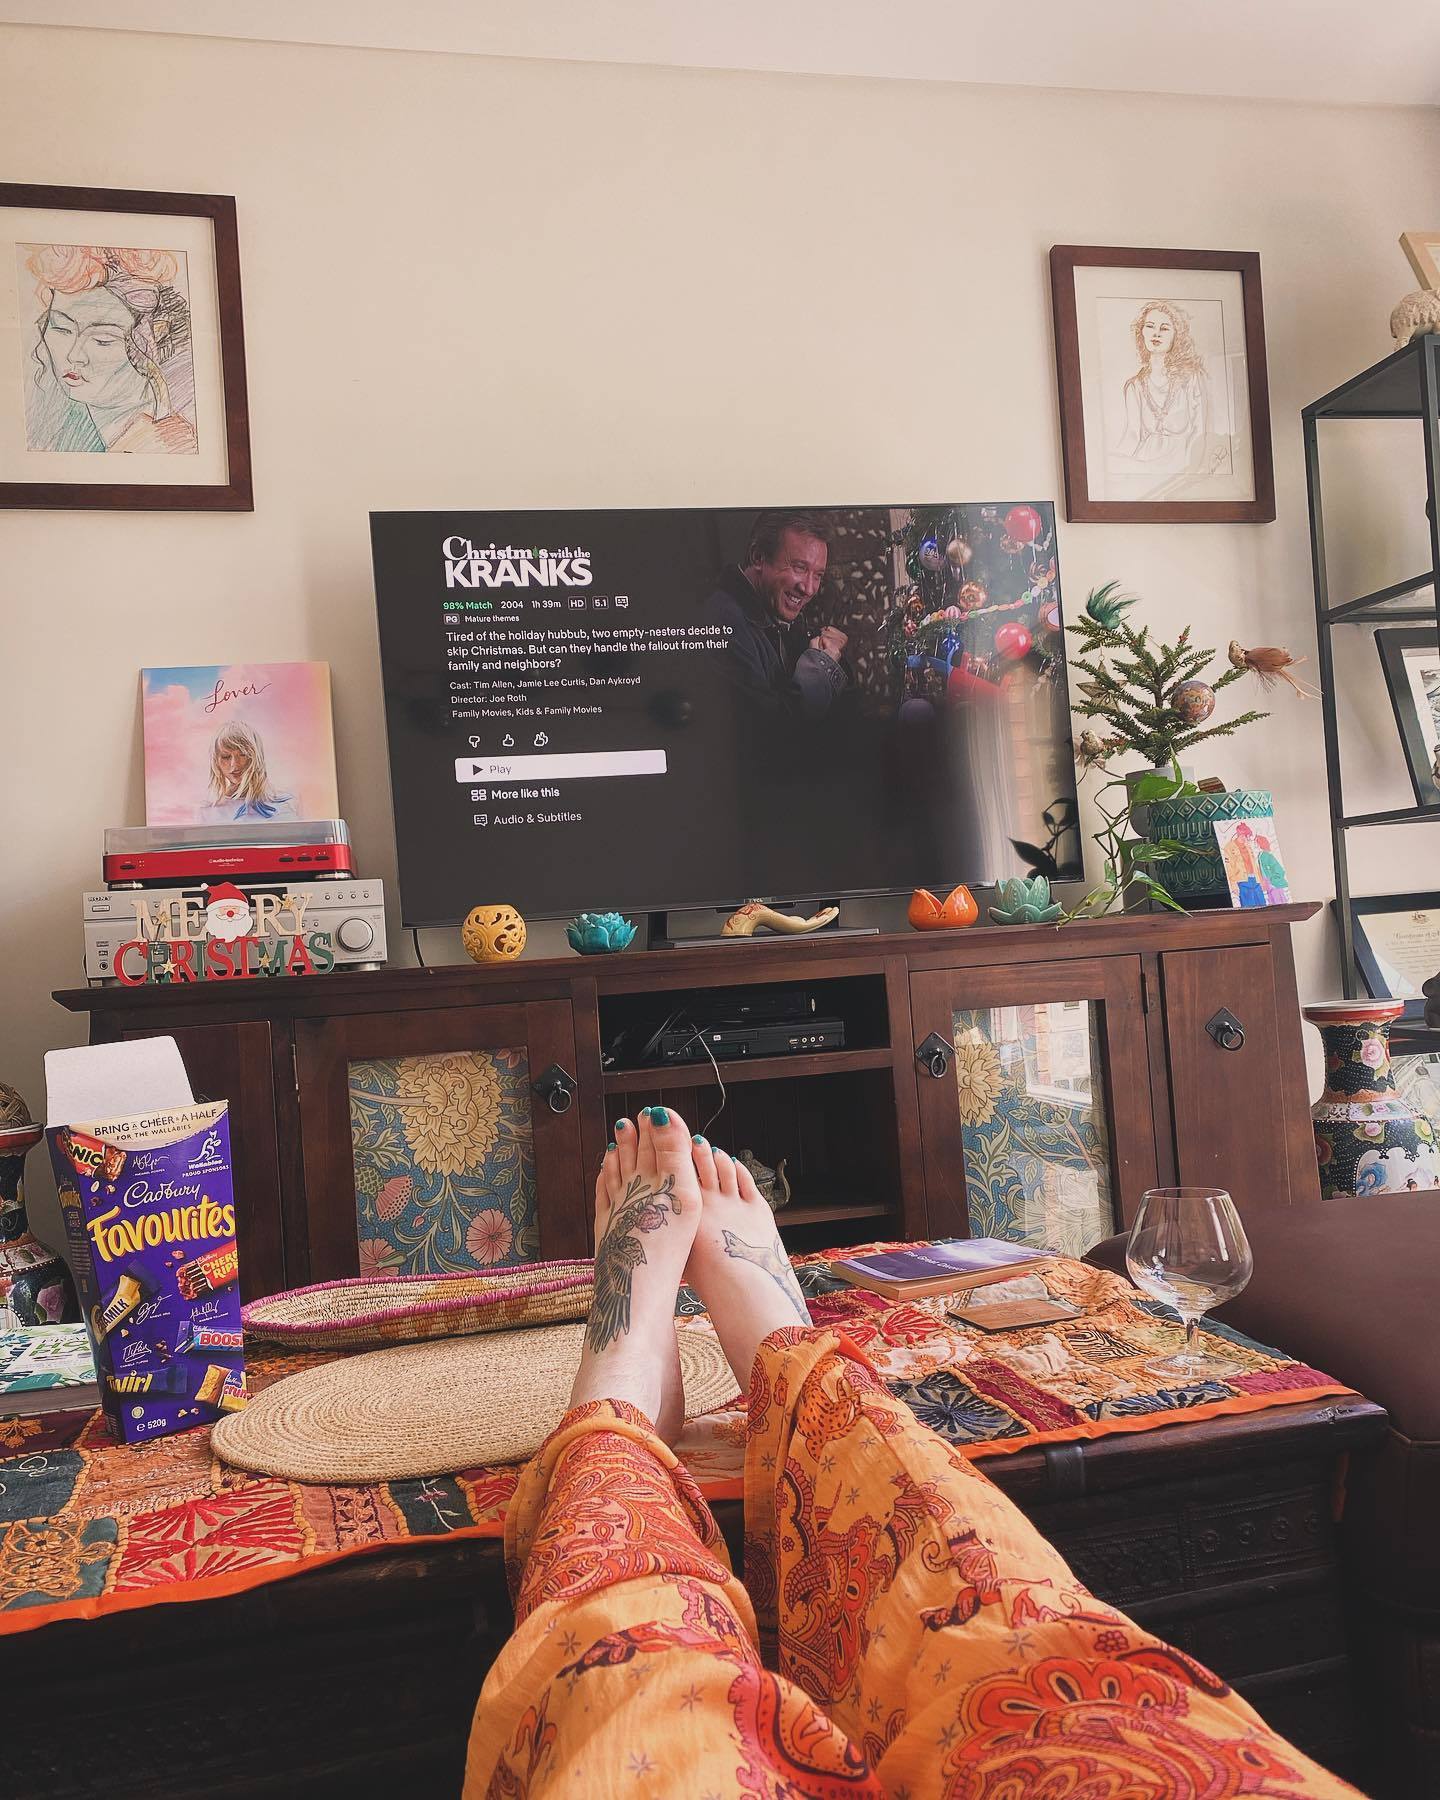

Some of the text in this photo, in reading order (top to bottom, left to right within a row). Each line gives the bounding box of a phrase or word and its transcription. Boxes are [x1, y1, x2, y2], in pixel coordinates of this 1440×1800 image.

[442, 535, 591, 560] Christms with the
[444, 558, 593, 588] KRANKS
[443, 598, 607, 610] 98% Match 2004 1h 39m HD 5.1
[445, 614, 520, 623] PG Mature themes
[446, 624, 734, 642] Tired of the holiday hubbub, two empty-nesters decide to
[447, 638, 729, 658] skip Christmas. But can they handle the fallout from their
[447, 658, 562, 673] family and neighbors?
[449, 675, 641, 690] Cast: Tim Allen, Jamie Lee Curtis, Dan Aykroyd
[202, 679, 273, 713] Lover
[450, 693, 527, 704] Director: Joe Roth
[452, 705, 603, 719] Family Movies, Kids & Family Movies
[489, 764, 512, 775] Play
[491, 786, 560, 800] More like this
[493, 811, 582, 825] Audio & Subtitles
[130, 892, 314, 942] MERY
[113, 931, 335, 987] CHRISTMAS
[94, 1122, 130, 1136] BRING
[139, 1115, 175, 1129] CHEER
[180, 1113, 189, 1123] A
[190, 1108, 217, 1121] HALF
[135, 1130, 149, 1138] THE
[151, 1123, 192, 1135] WALLABIES
[123, 1178, 201, 1208] Cadbury
[86, 1194, 236, 1263] Favourites
[199, 1332, 243, 1348] BOOS
[147, 1418, 167, 1430] 520g
